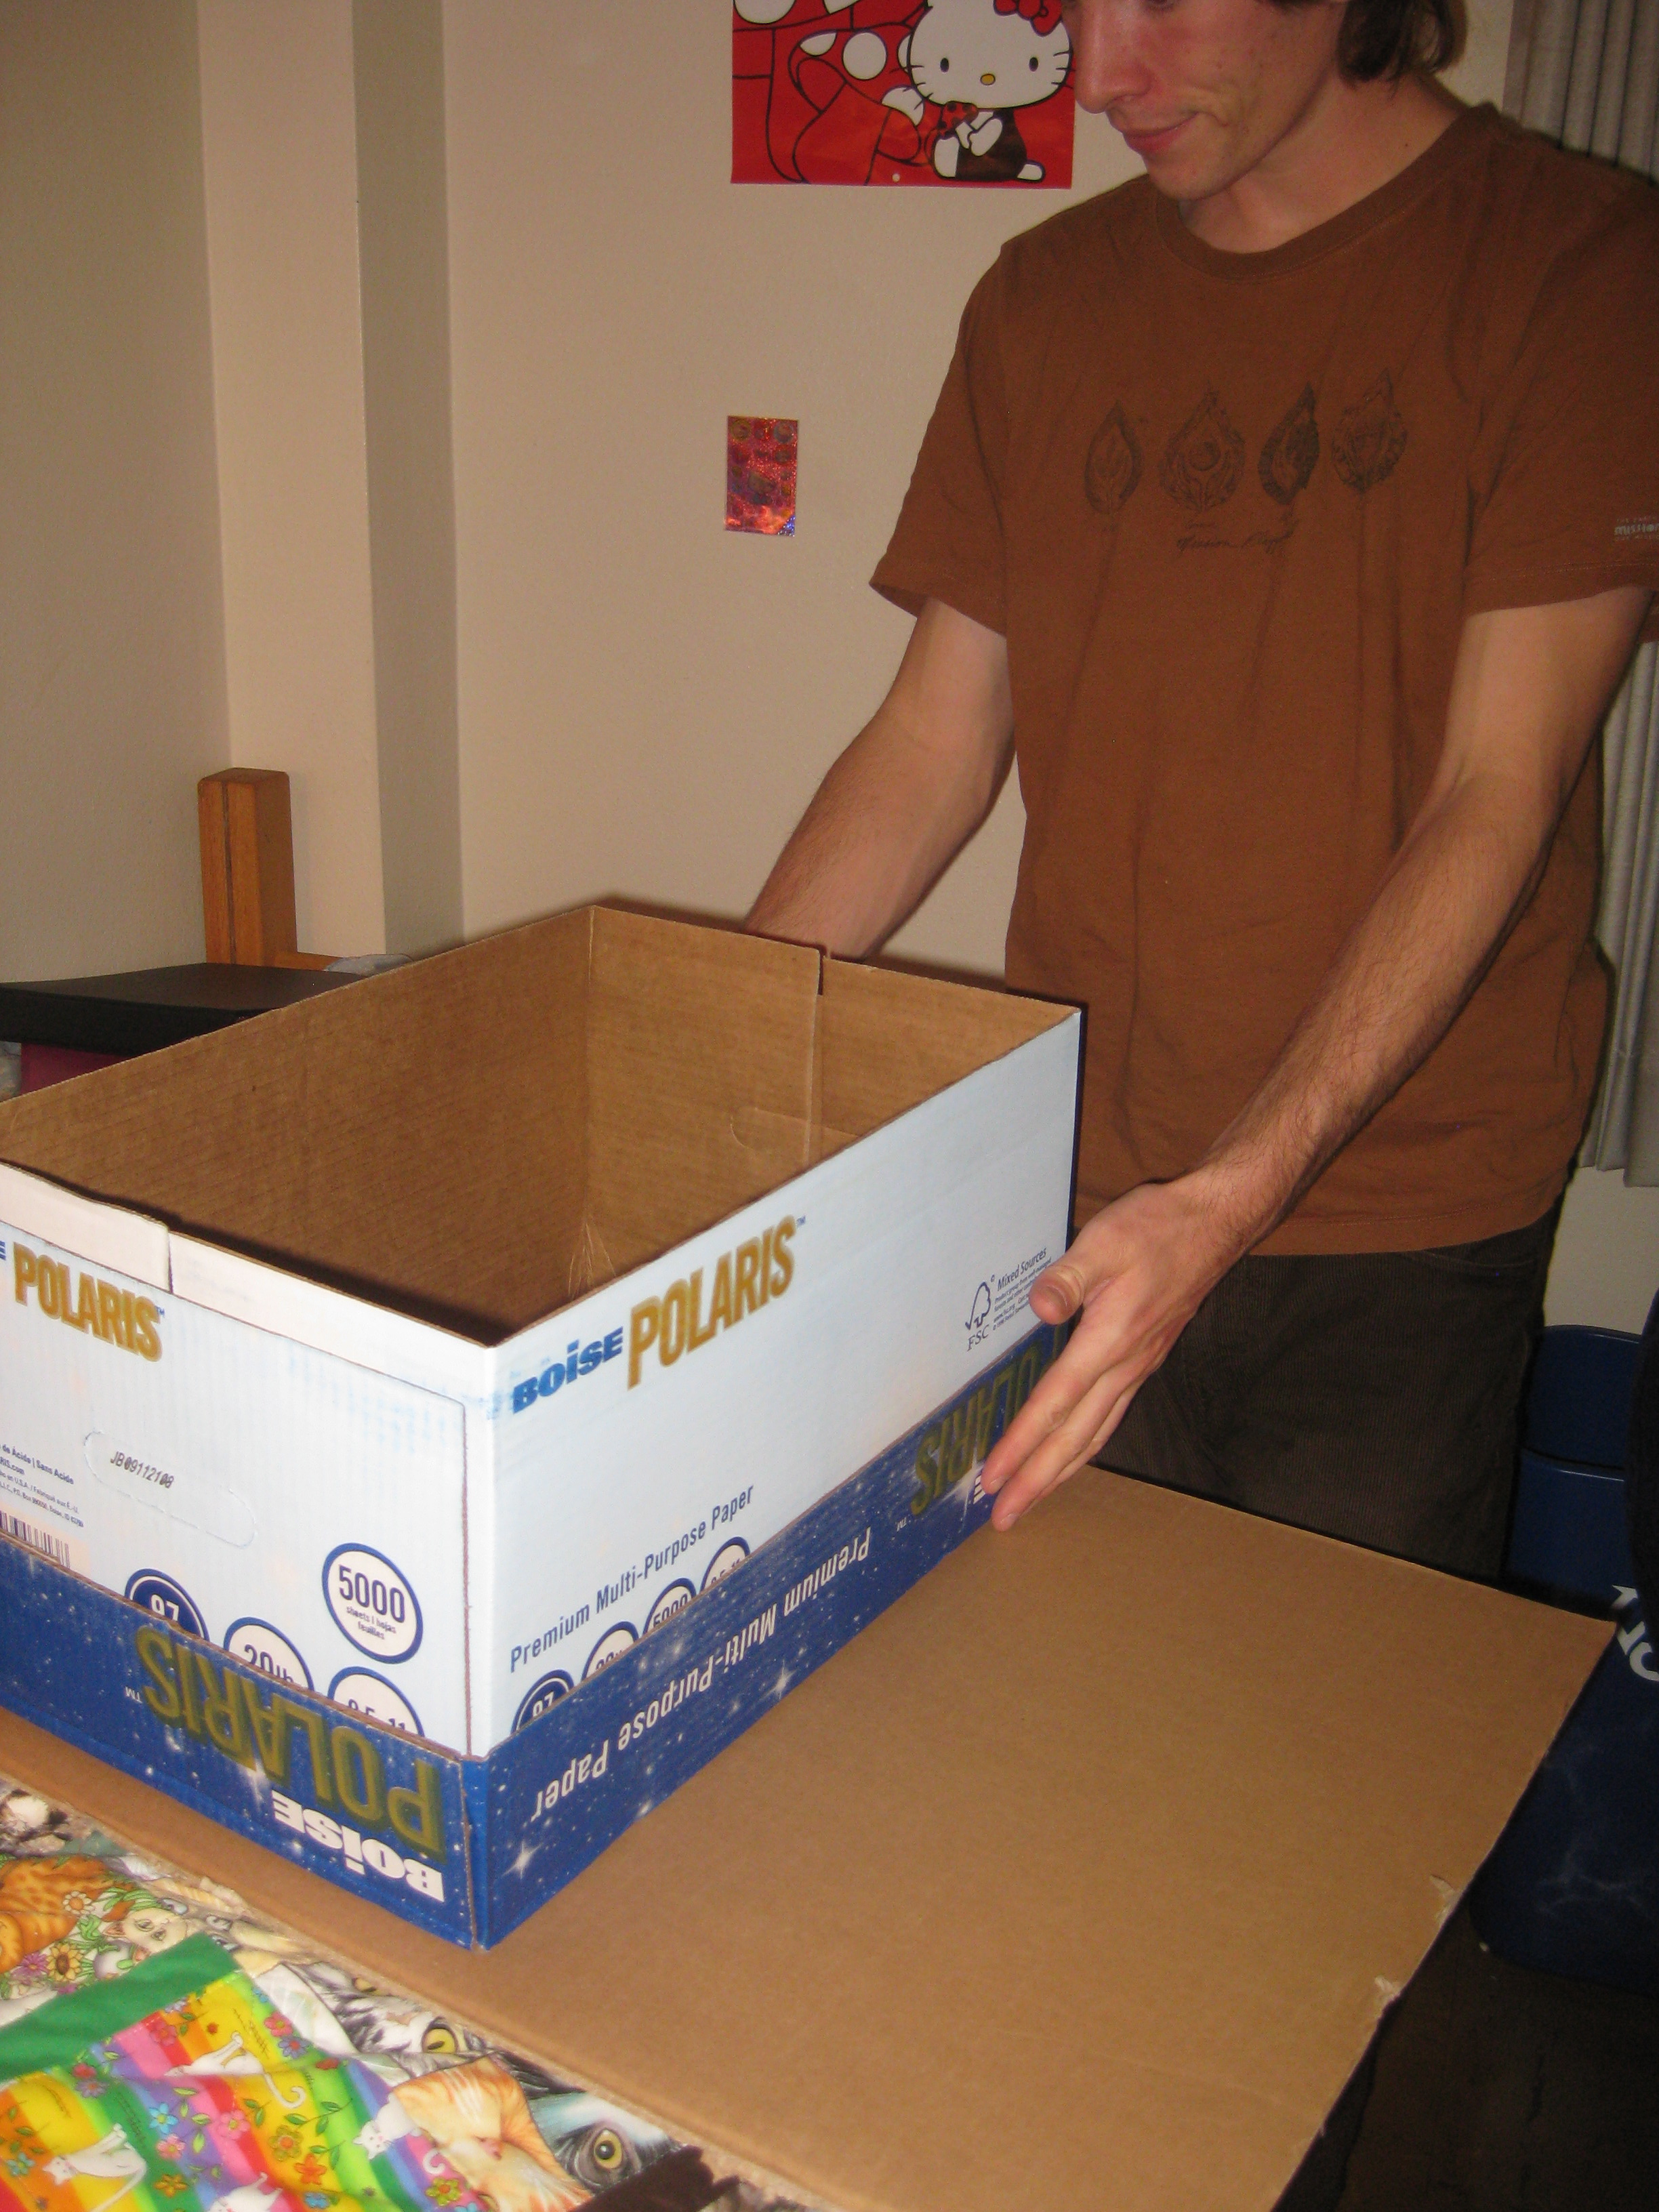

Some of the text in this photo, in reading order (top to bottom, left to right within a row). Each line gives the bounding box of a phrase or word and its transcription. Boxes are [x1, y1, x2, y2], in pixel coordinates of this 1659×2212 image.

[14, 1241, 162, 1362] POLARIS
[628, 1214, 796, 1391] POLARIS
[966, 1325, 989, 1352] FSC
[998, 1248, 1046, 1292] Mixed Sources
[338, 1563, 405, 1624] 5000
[510, 1484, 754, 1674] Premium Multi-Purpose Paper
[137, 1626, 445, 1861] POLARIS
[530, 1527, 872, 1822] Premium Multi-Purpose Paper
